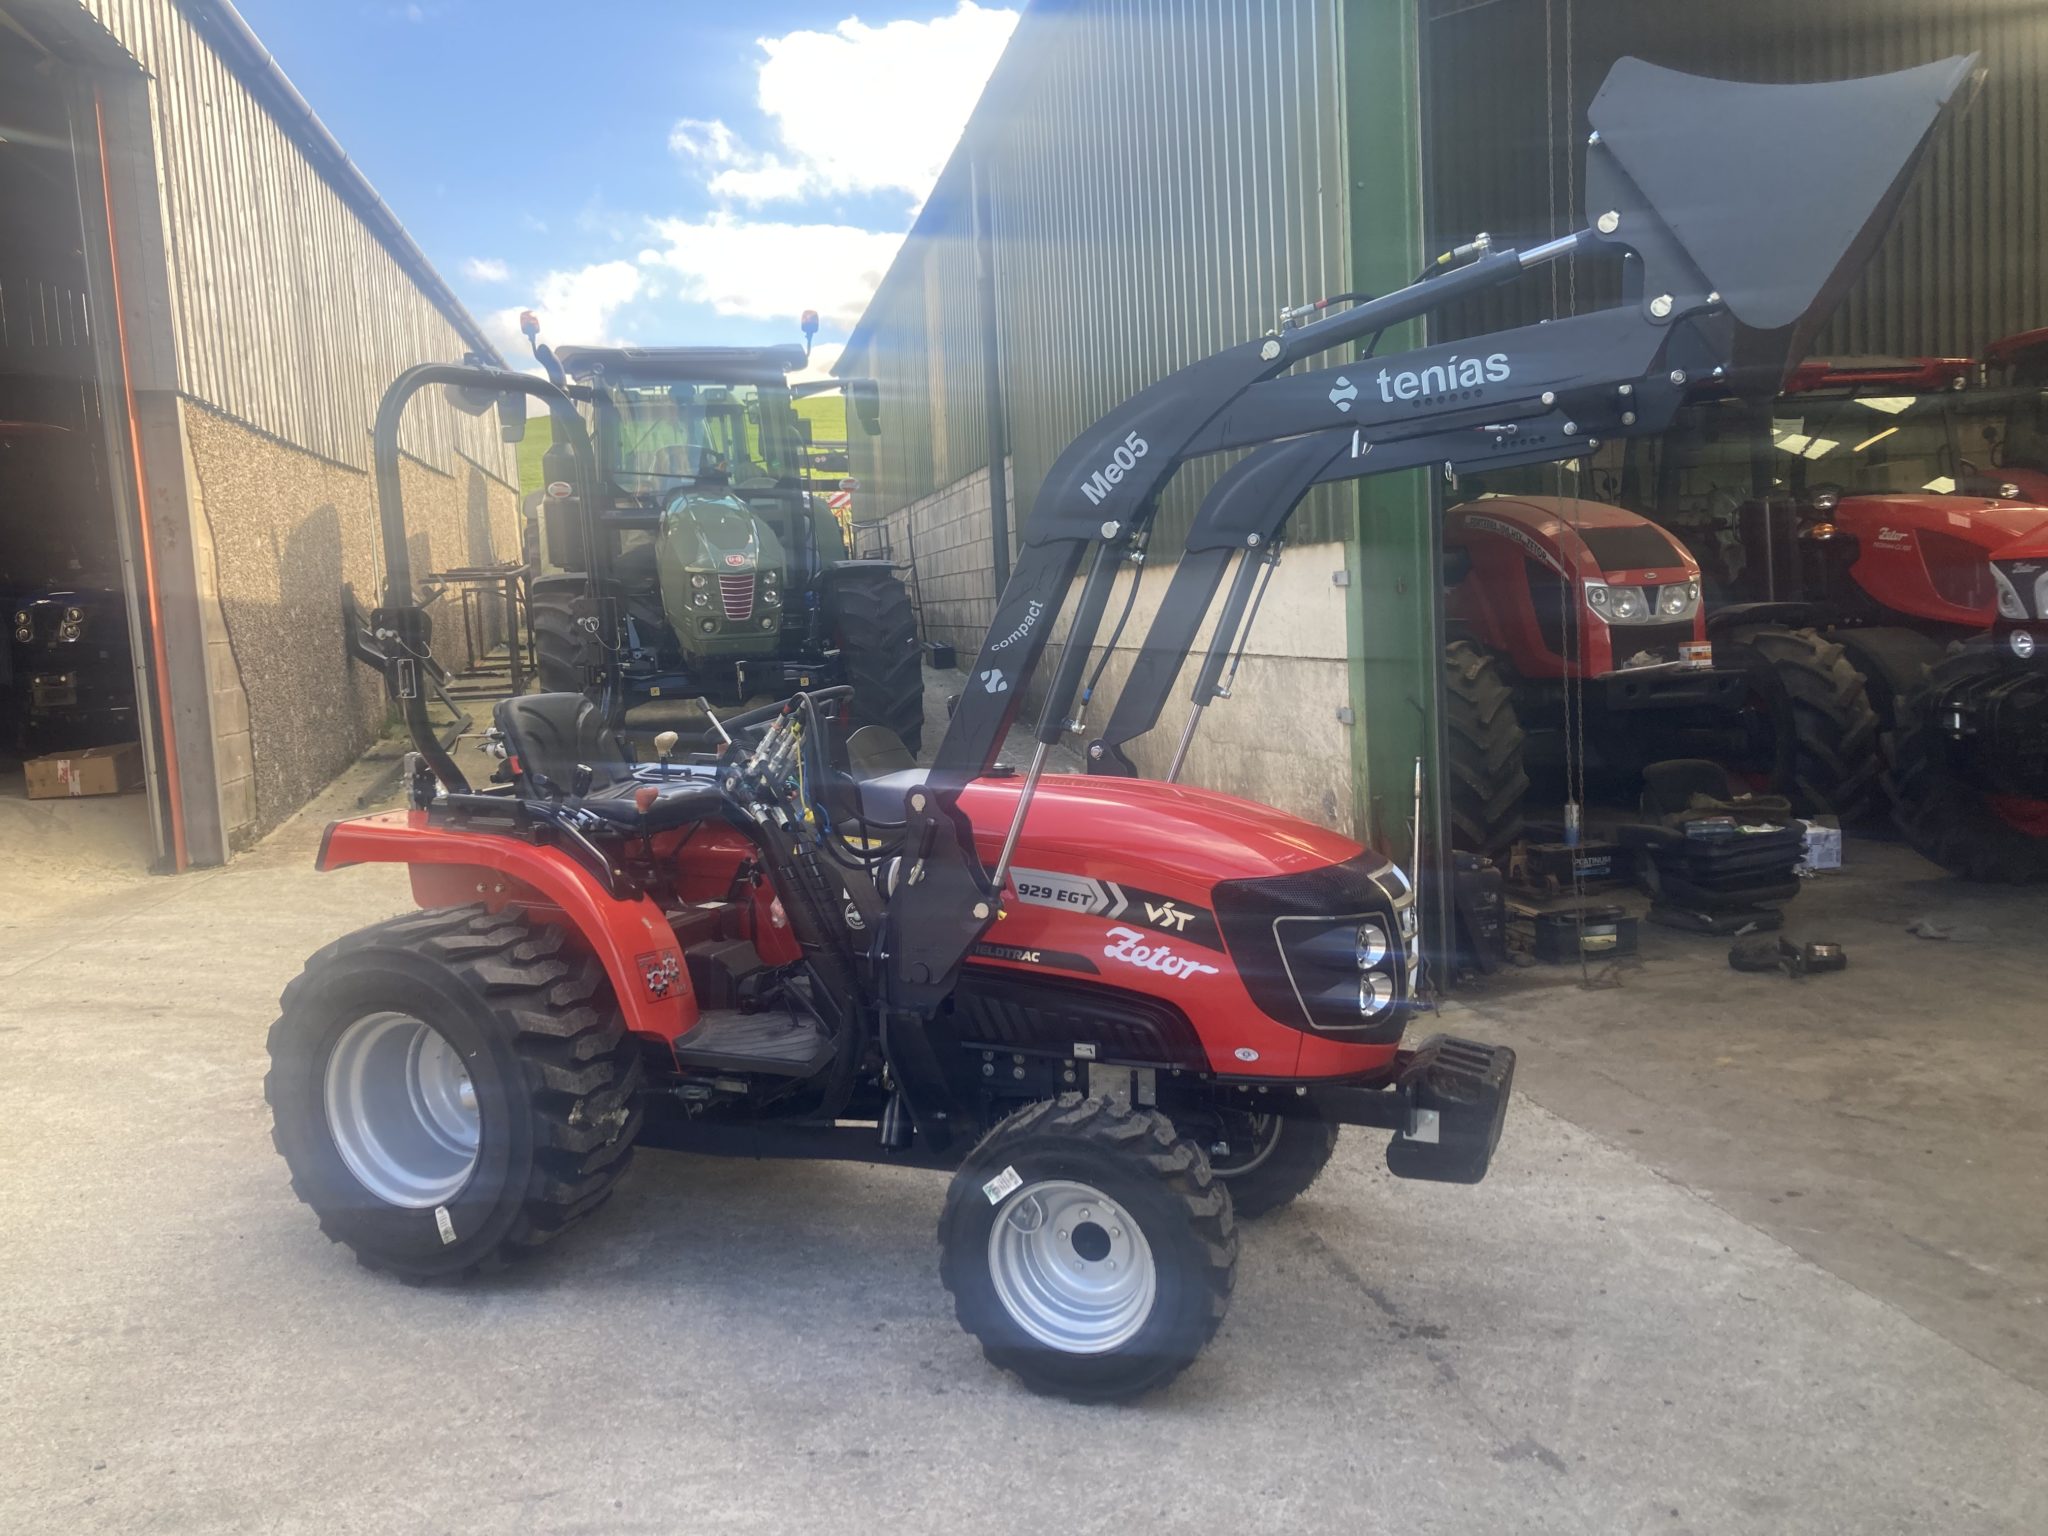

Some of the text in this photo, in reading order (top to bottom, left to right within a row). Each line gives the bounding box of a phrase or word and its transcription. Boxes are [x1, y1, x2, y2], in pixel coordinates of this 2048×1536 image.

[1376, 353, 1511, 403] tenías
[1080, 430, 1149, 506] Me05
[991, 600, 1044, 651] compact
[1018, 883, 1093, 906] 929 EGT
[1144, 901, 1196, 931] VST
[975, 944, 1041, 963] IELDTRAC
[1103, 926, 1220, 980] Zetor
